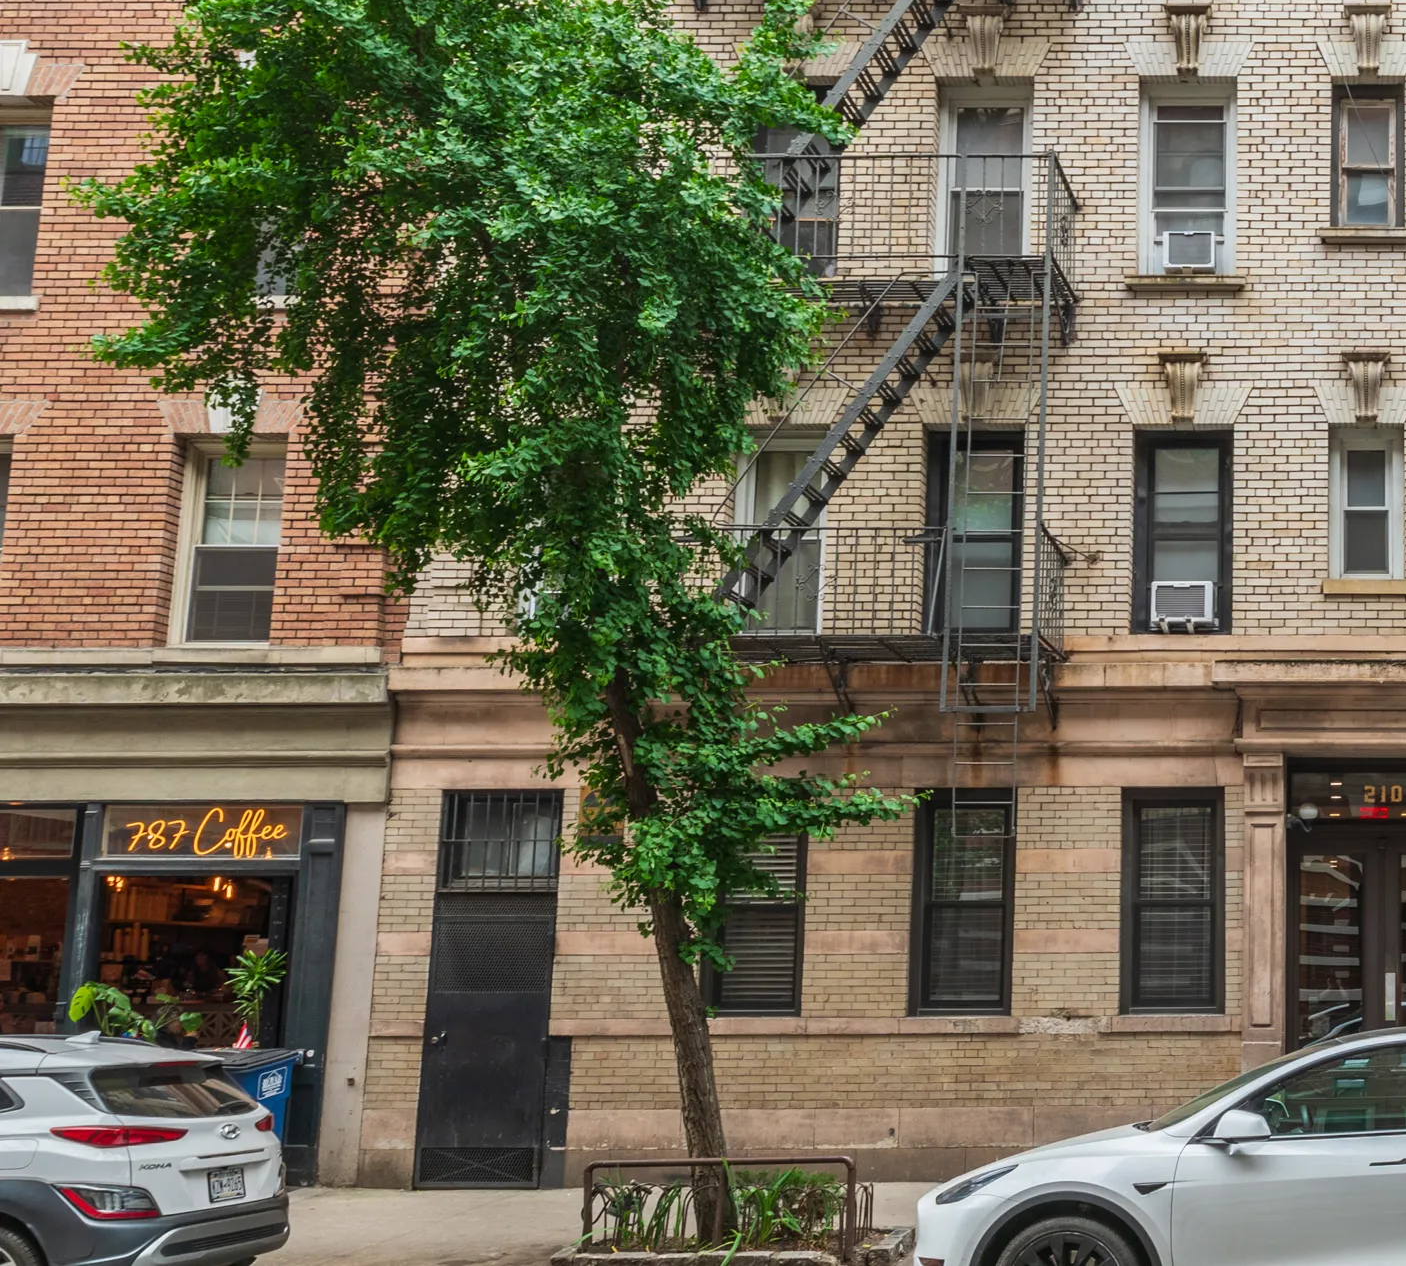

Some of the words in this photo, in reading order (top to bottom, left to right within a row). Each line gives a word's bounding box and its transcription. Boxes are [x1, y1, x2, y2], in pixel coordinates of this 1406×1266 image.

[1363, 785, 1403, 803] 210
[125, 819, 190, 852] 787
[193, 807, 288, 859] Coffee
[138, 1162, 172, 1171] KONA
